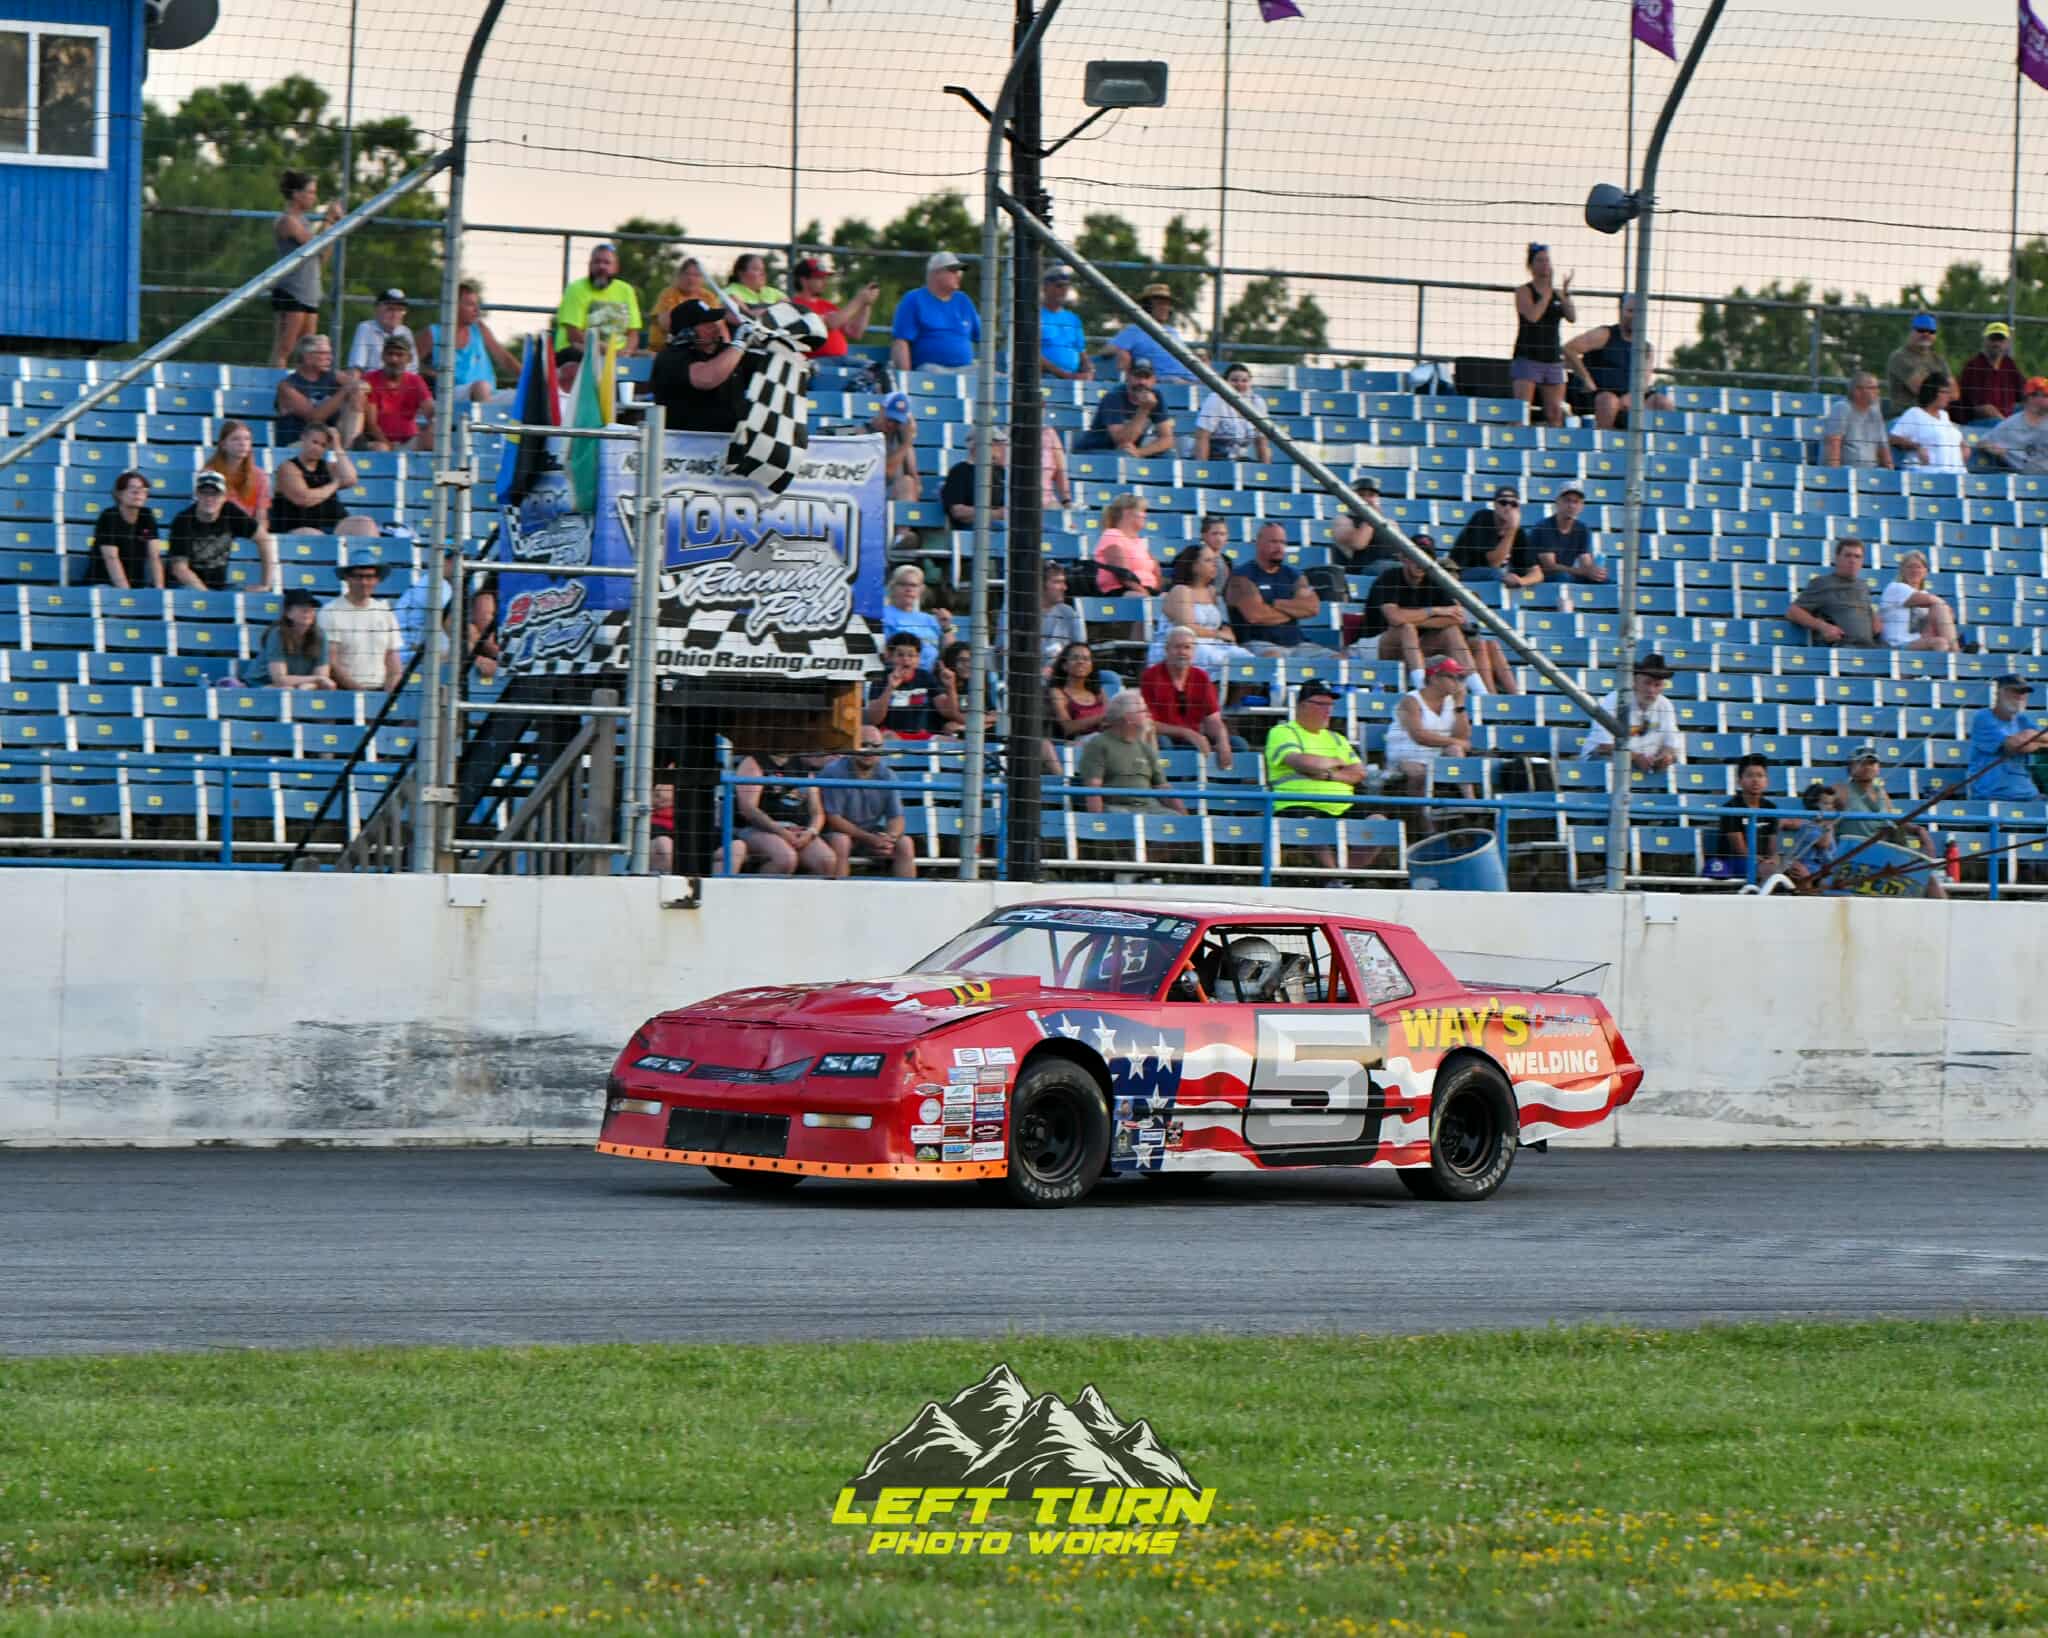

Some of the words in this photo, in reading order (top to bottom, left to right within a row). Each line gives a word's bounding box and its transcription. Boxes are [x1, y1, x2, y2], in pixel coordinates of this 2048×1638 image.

[662, 494, 849, 569] LORAIN
[682, 561, 847, 602] Raceway
[746, 590, 847, 635] Park
[1398, 996, 1530, 1048] WAY'S
[1244, 1010, 1373, 1148] 5
[1505, 1049, 1599, 1075] WELDING
